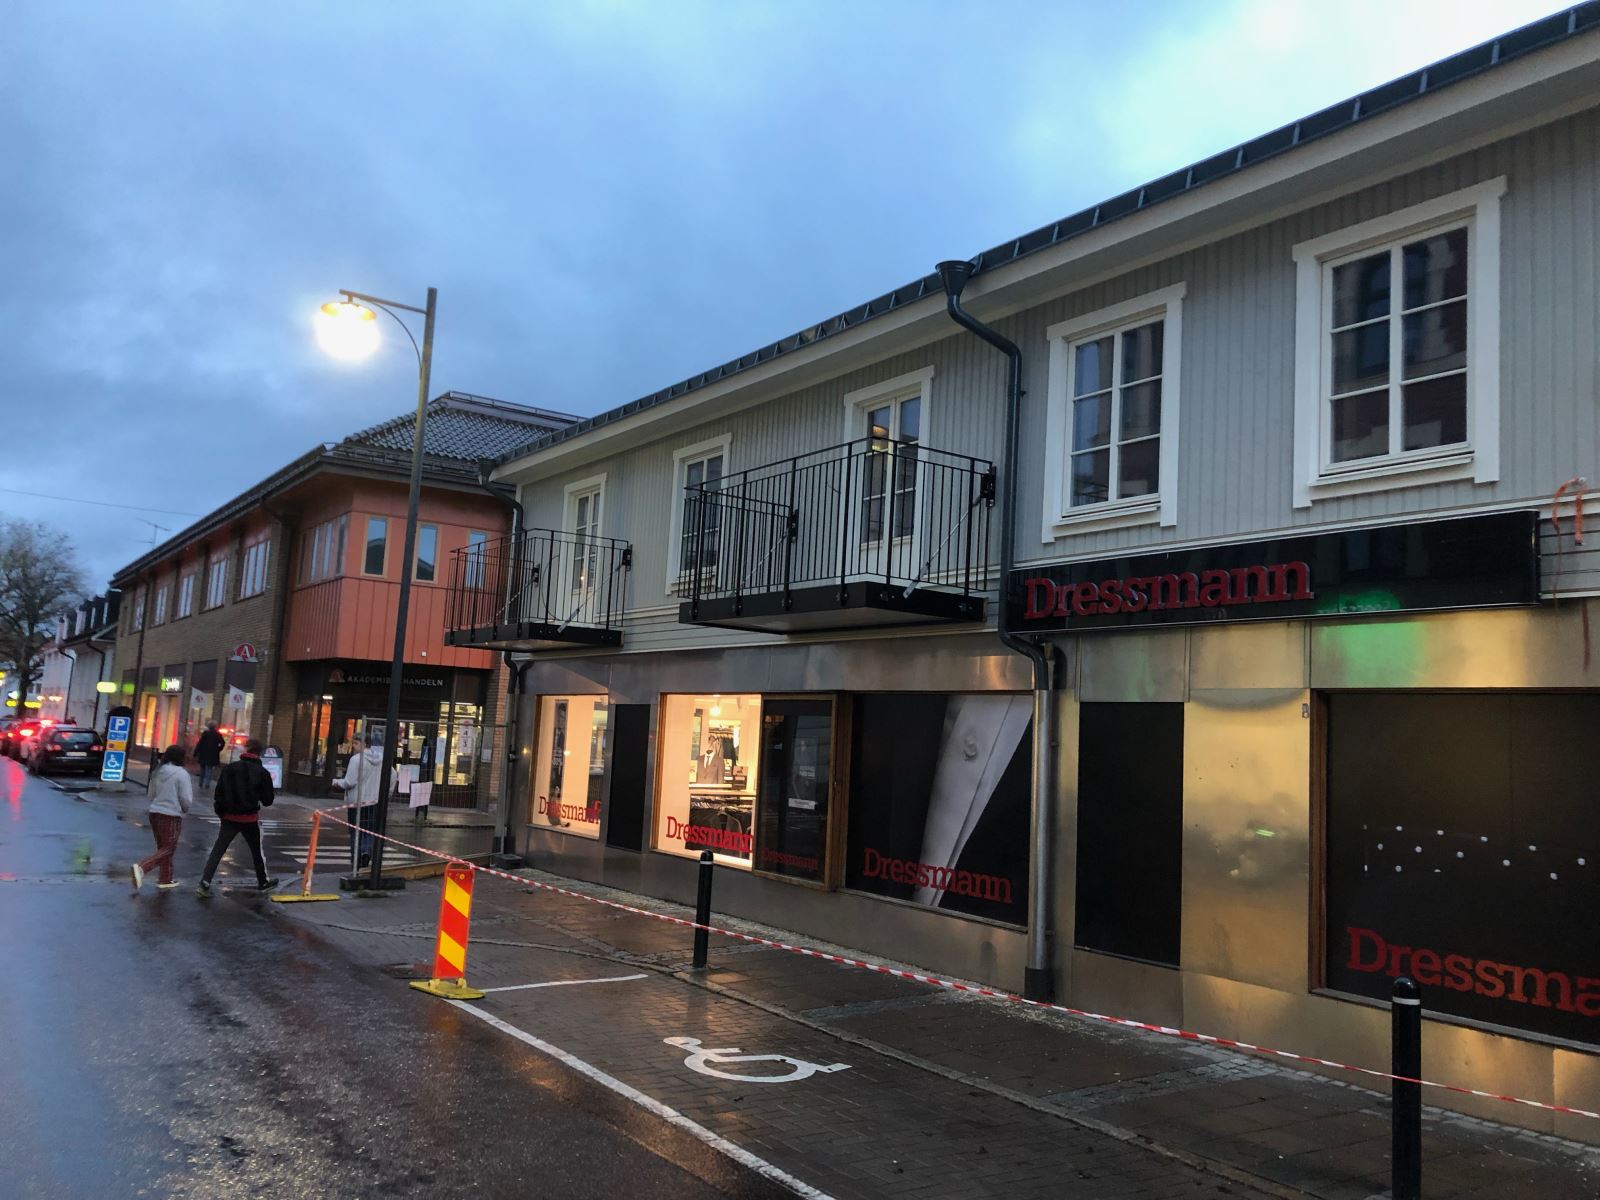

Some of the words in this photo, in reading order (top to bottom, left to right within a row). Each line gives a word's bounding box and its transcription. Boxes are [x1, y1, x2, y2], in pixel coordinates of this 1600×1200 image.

[1023, 560, 1314, 620] Dressmann
[347, 674, 444, 687] AKADEMIBHANDELN
[115, 718, 126, 731] P
[863, 848, 1013, 904] Dressmann
